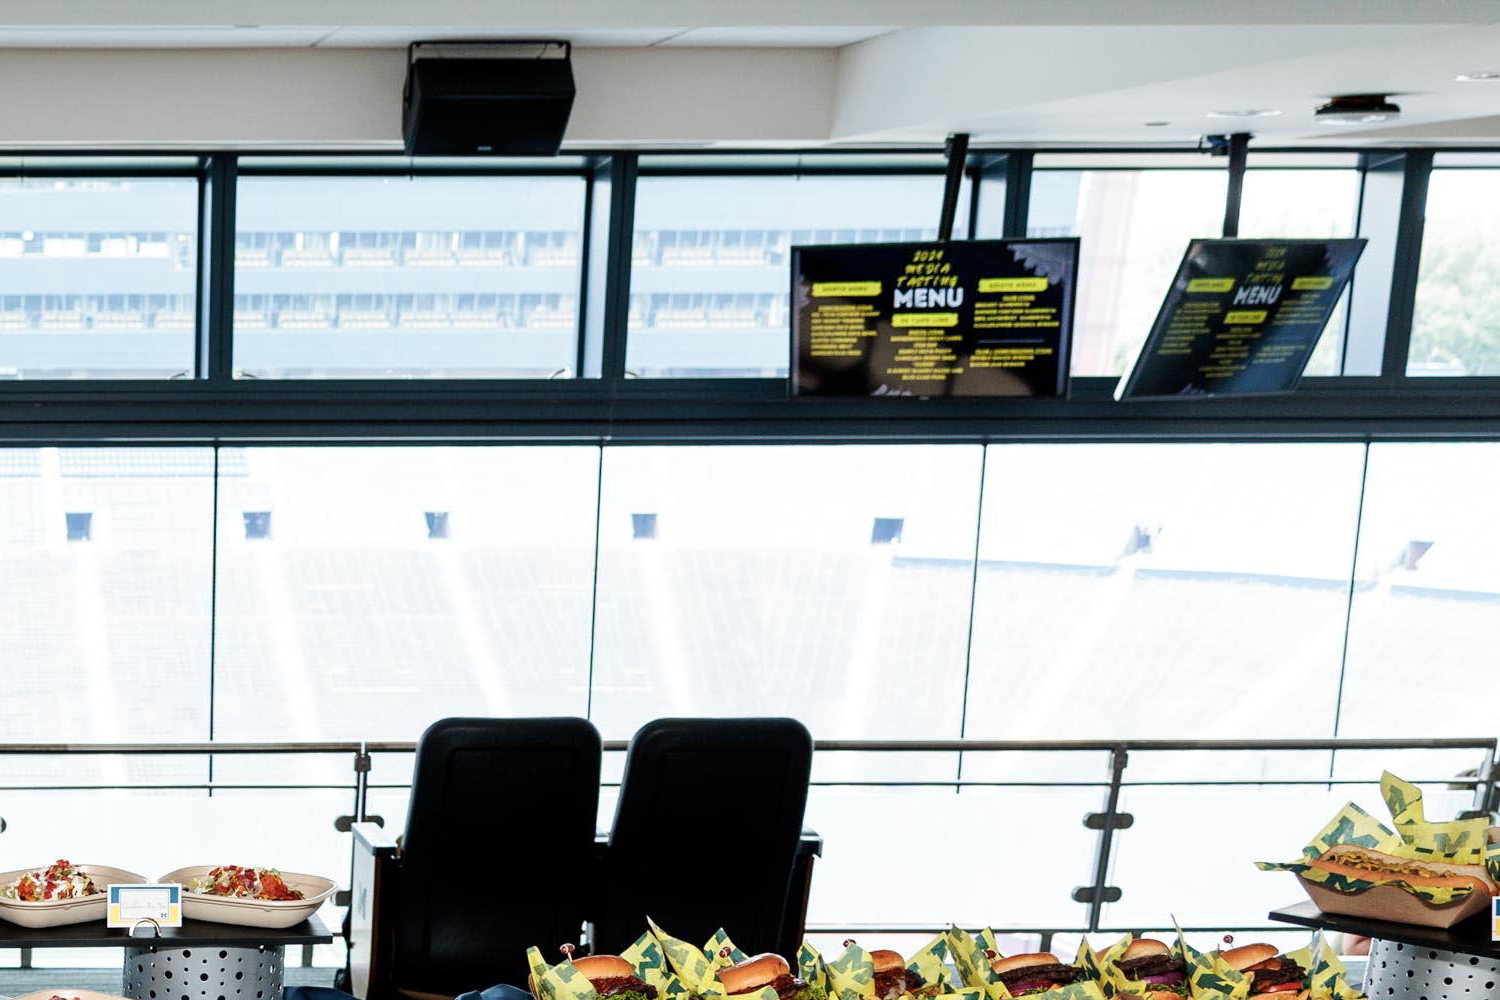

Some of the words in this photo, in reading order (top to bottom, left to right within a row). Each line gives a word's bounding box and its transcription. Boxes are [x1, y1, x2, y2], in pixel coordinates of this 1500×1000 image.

[905, 262, 951, 274] MEDIA
[897, 274, 958, 288] TASTING
[893, 286, 964, 308] MENU
[1233, 285, 1283, 305] MENU
